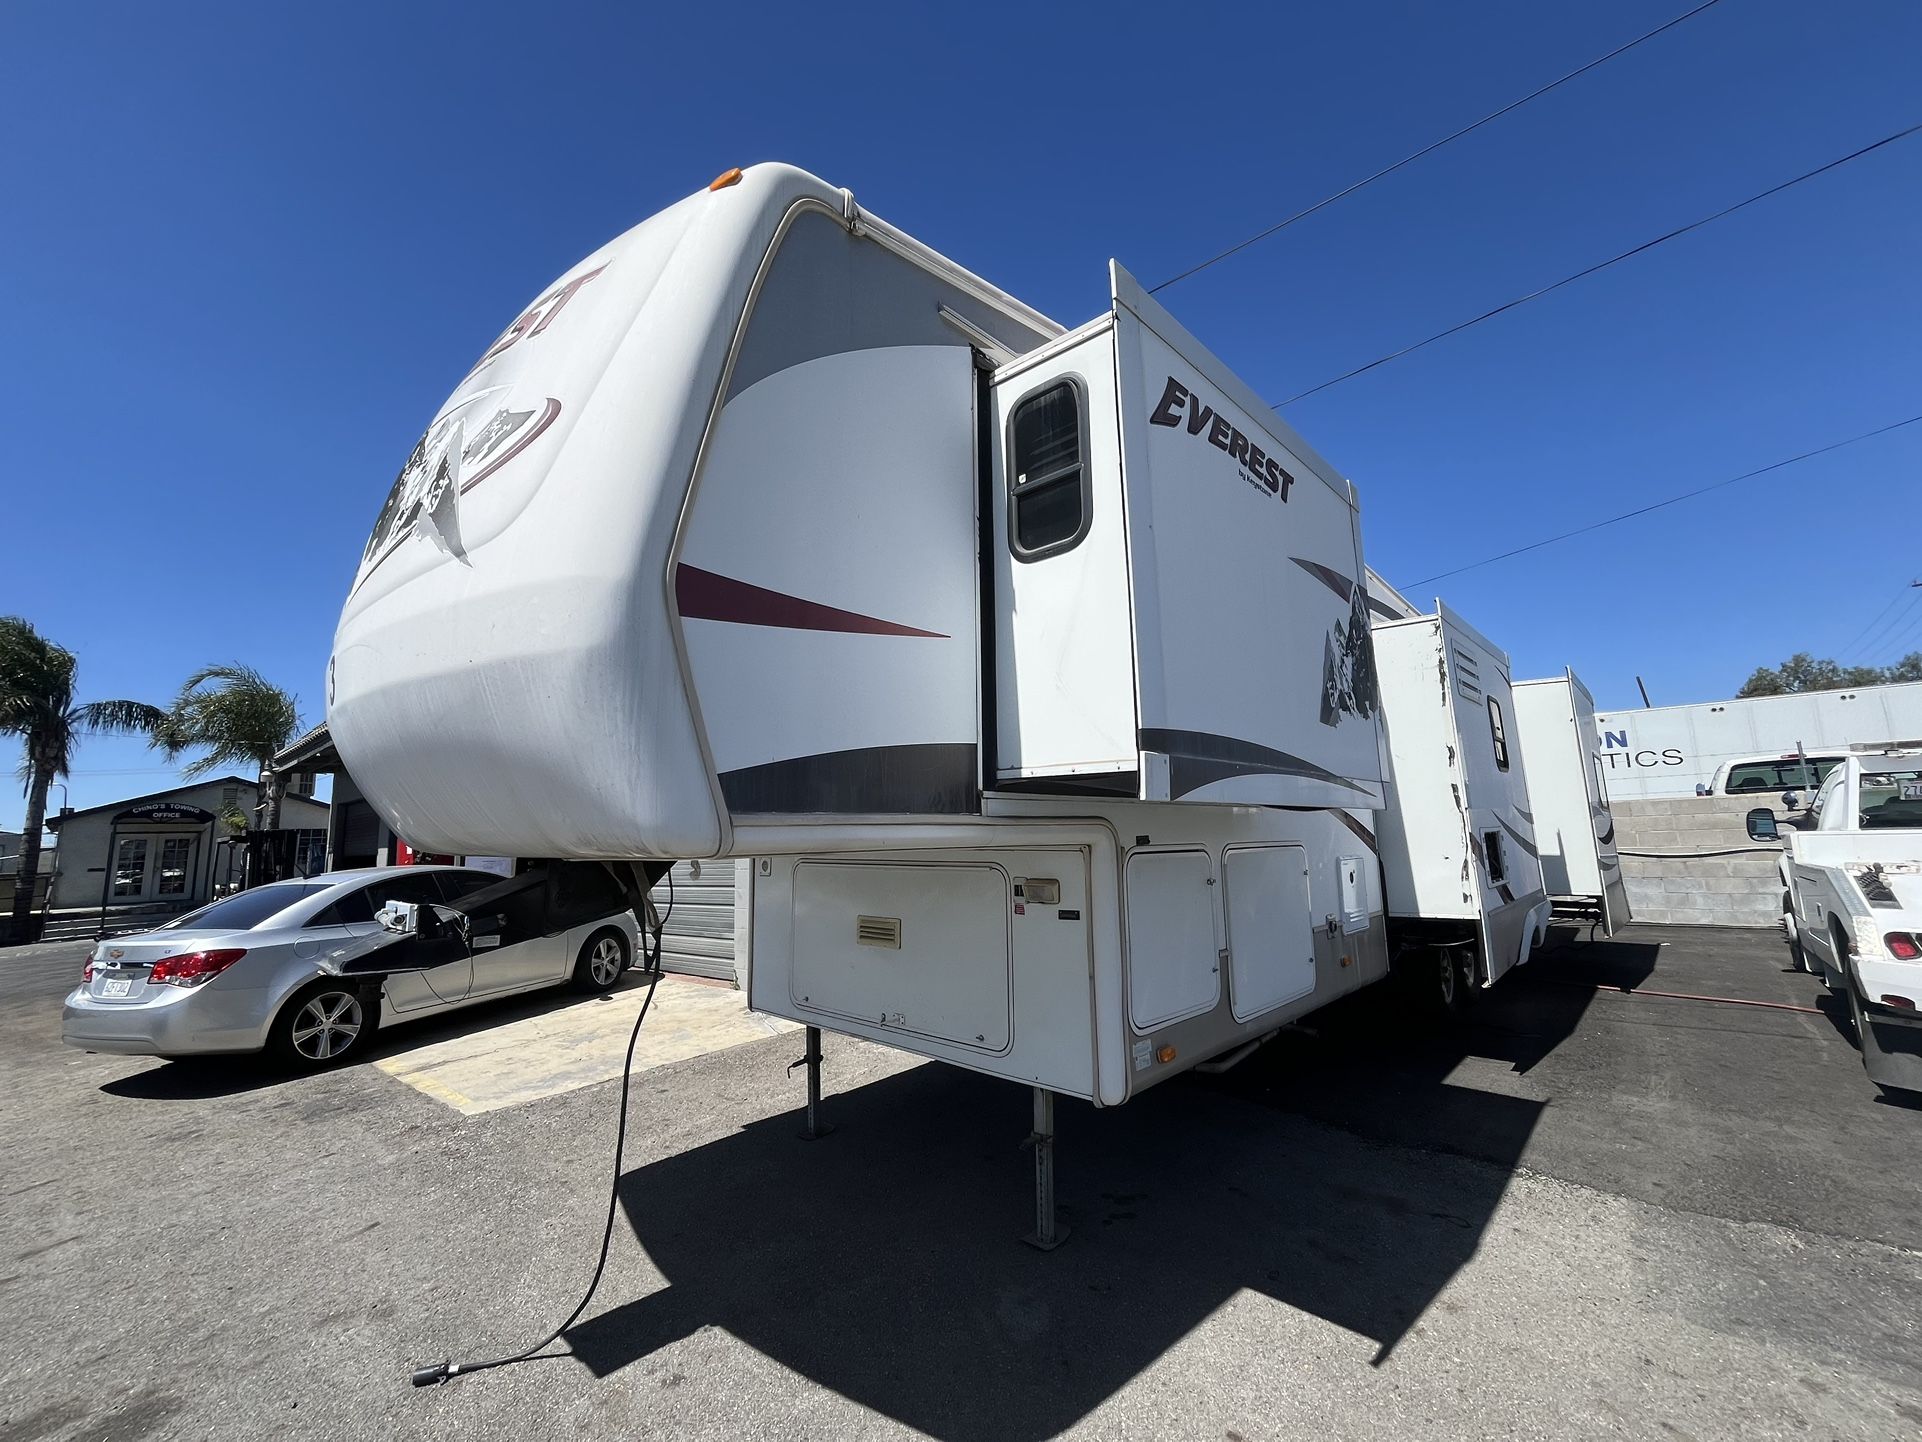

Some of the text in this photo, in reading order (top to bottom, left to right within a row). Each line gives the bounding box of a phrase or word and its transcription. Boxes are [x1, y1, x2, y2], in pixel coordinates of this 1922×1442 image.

[1149, 375, 1295, 504] EVEREST
[1598, 730, 1628, 749] N
[1601, 748, 1684, 769] TICS
[132, 803, 201, 814] CHINO'S TOWING
